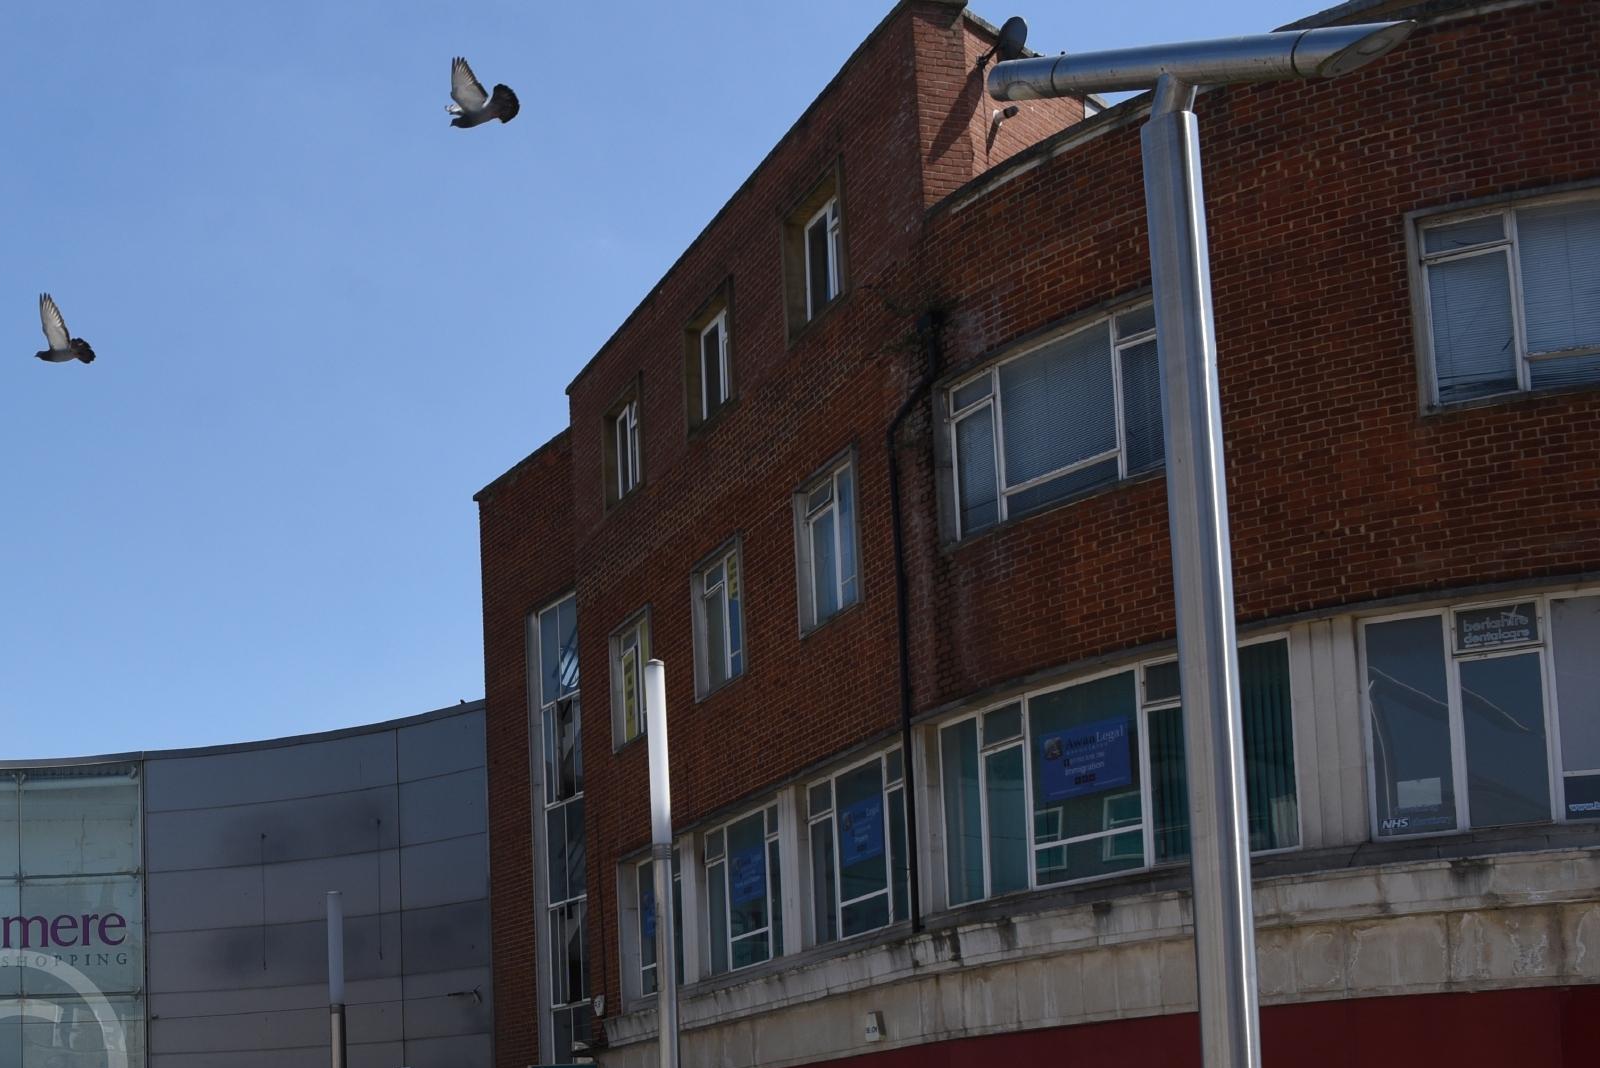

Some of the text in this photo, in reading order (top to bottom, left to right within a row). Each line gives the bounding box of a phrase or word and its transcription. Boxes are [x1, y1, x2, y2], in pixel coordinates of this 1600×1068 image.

[1463, 614, 1529, 633] berkshire
[1464, 628, 1530, 644] dentalcare
[1096, 723, 1124, 743] Legal
[1382, 818, 1409, 830] NHS
[1, 952, 129, 968] SHOPPING
